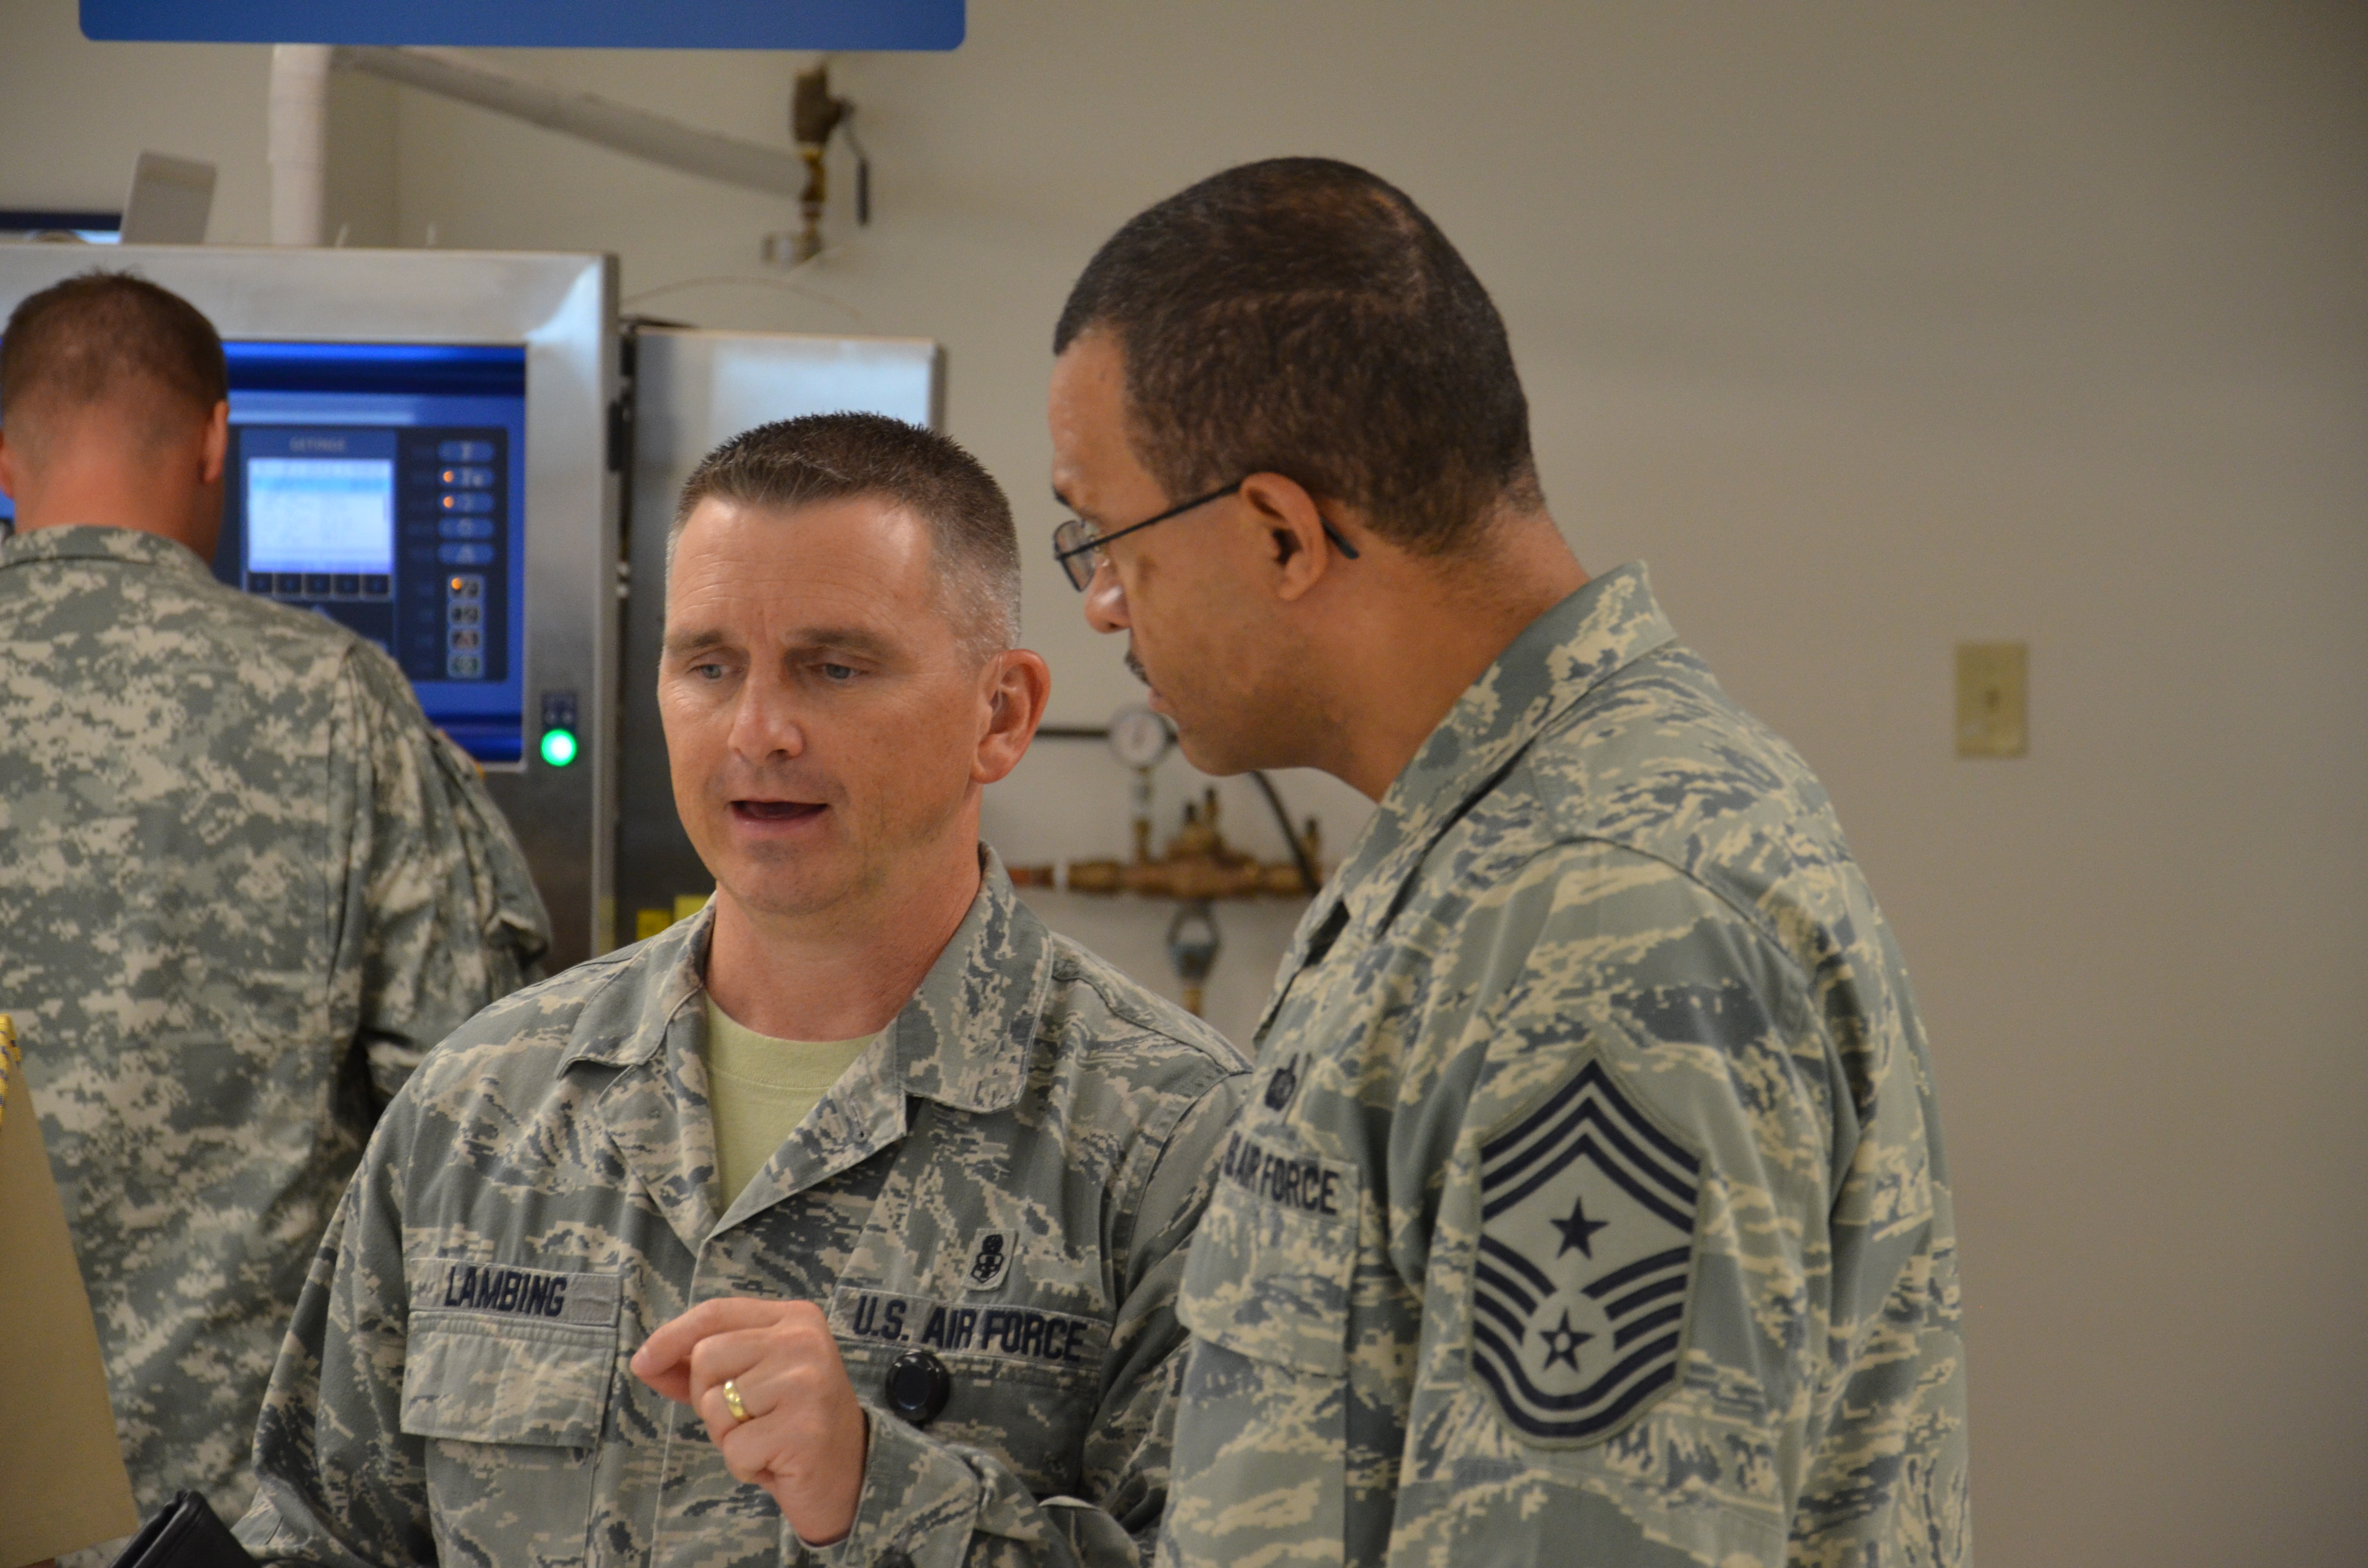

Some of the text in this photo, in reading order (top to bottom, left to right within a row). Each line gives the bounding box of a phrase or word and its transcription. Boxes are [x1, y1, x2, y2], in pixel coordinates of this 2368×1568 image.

[1260, 1153, 1339, 1215] FORCE
[444, 1265, 567, 1316] LAMBING
[852, 1295, 1087, 1362] U.S. AIR FORCE
